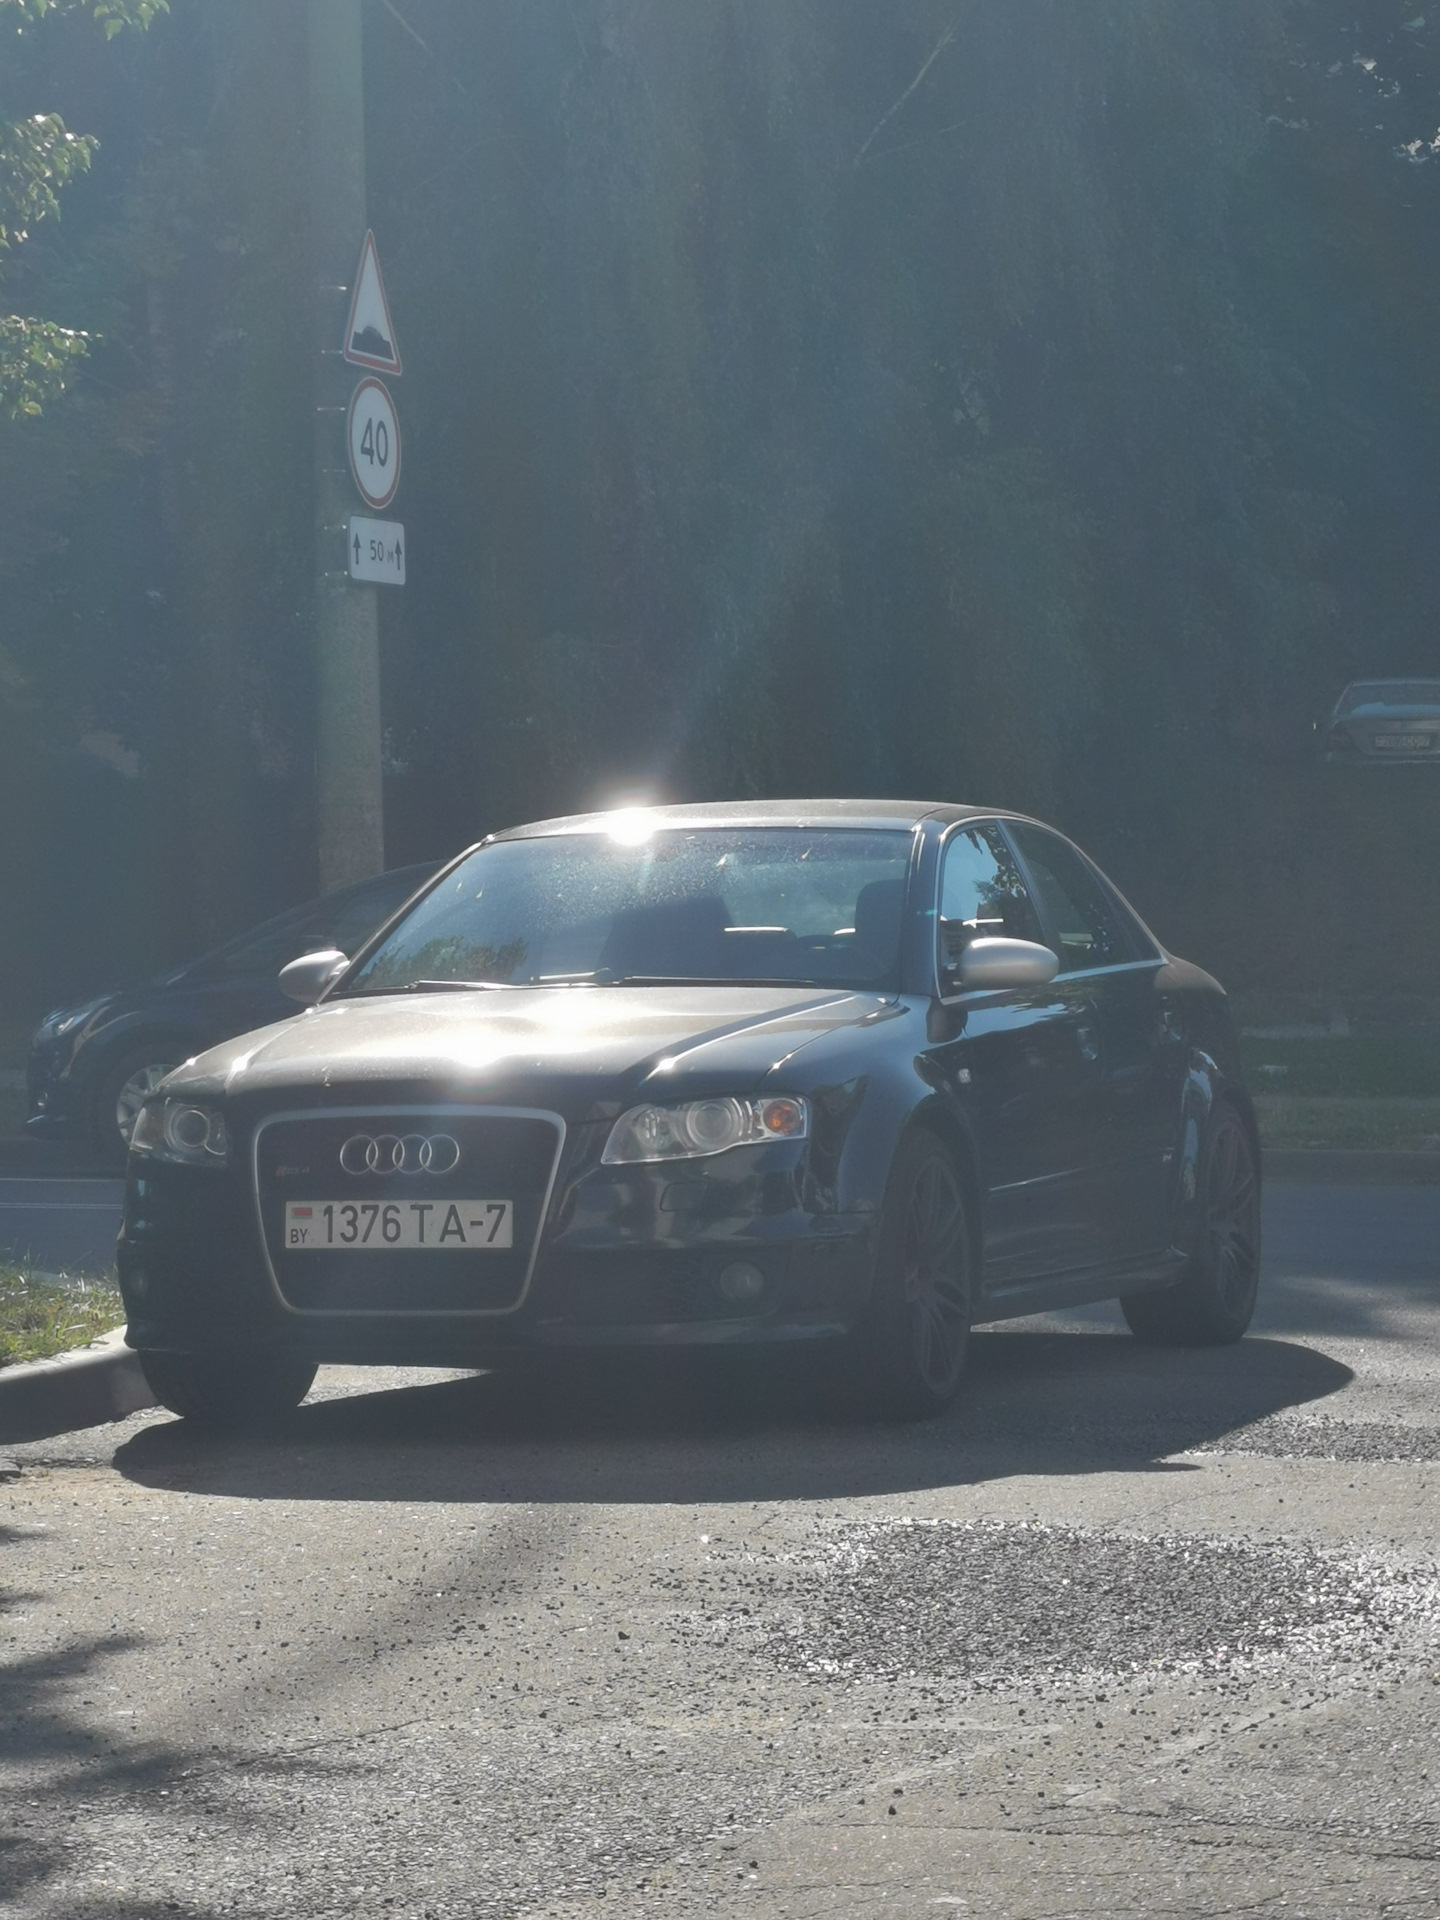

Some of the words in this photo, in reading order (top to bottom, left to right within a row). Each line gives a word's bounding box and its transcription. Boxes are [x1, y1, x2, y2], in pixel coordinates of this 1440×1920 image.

[360, 418, 389, 467] 40
[370, 539, 384, 562] 50
[290, 1228, 309, 1244] BY
[323, 1204, 401, 1243] 1376
[410, 1204, 506, 1243] TA-7
